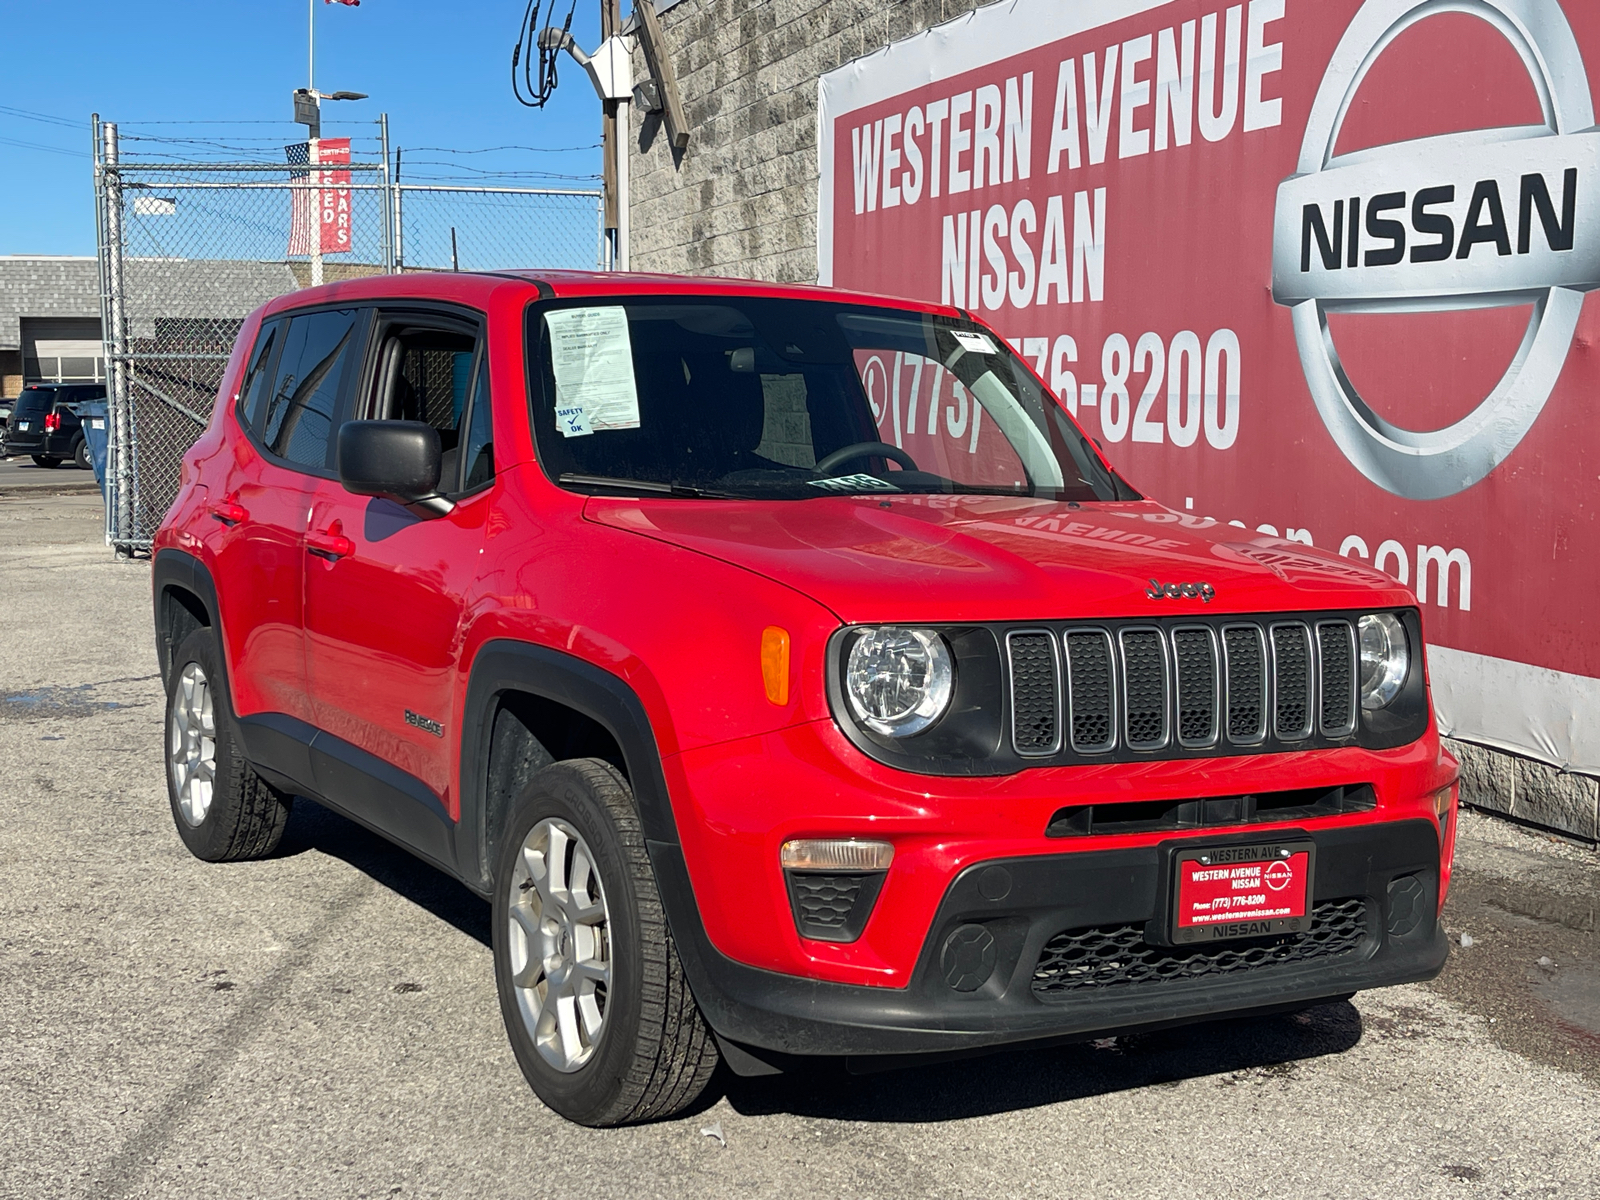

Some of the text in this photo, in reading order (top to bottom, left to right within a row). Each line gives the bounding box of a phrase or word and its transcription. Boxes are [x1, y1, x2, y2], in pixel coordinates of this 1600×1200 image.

[851, 0, 1285, 215] WESTERN AVENUE
[1300, 167, 1578, 273] NISSAN
[941, 187, 1107, 311] NISSAN
[1005, 328, 1241, 450] 76-8200
[557, 407, 583, 417] SAFETY
[570, 425, 584, 433] OK
[1145, 578, 1216, 604] Jeep
[1210, 848, 1258, 862] WESTERN
[1192, 866, 1261, 882] WESTERN AVENUE
[1232, 878, 1261, 890] NISSAN
[1212, 897, 1231, 909] (773)
[1232, 894, 1266, 906] 776-8200
[1213, 921, 1271, 938] NISSAN
